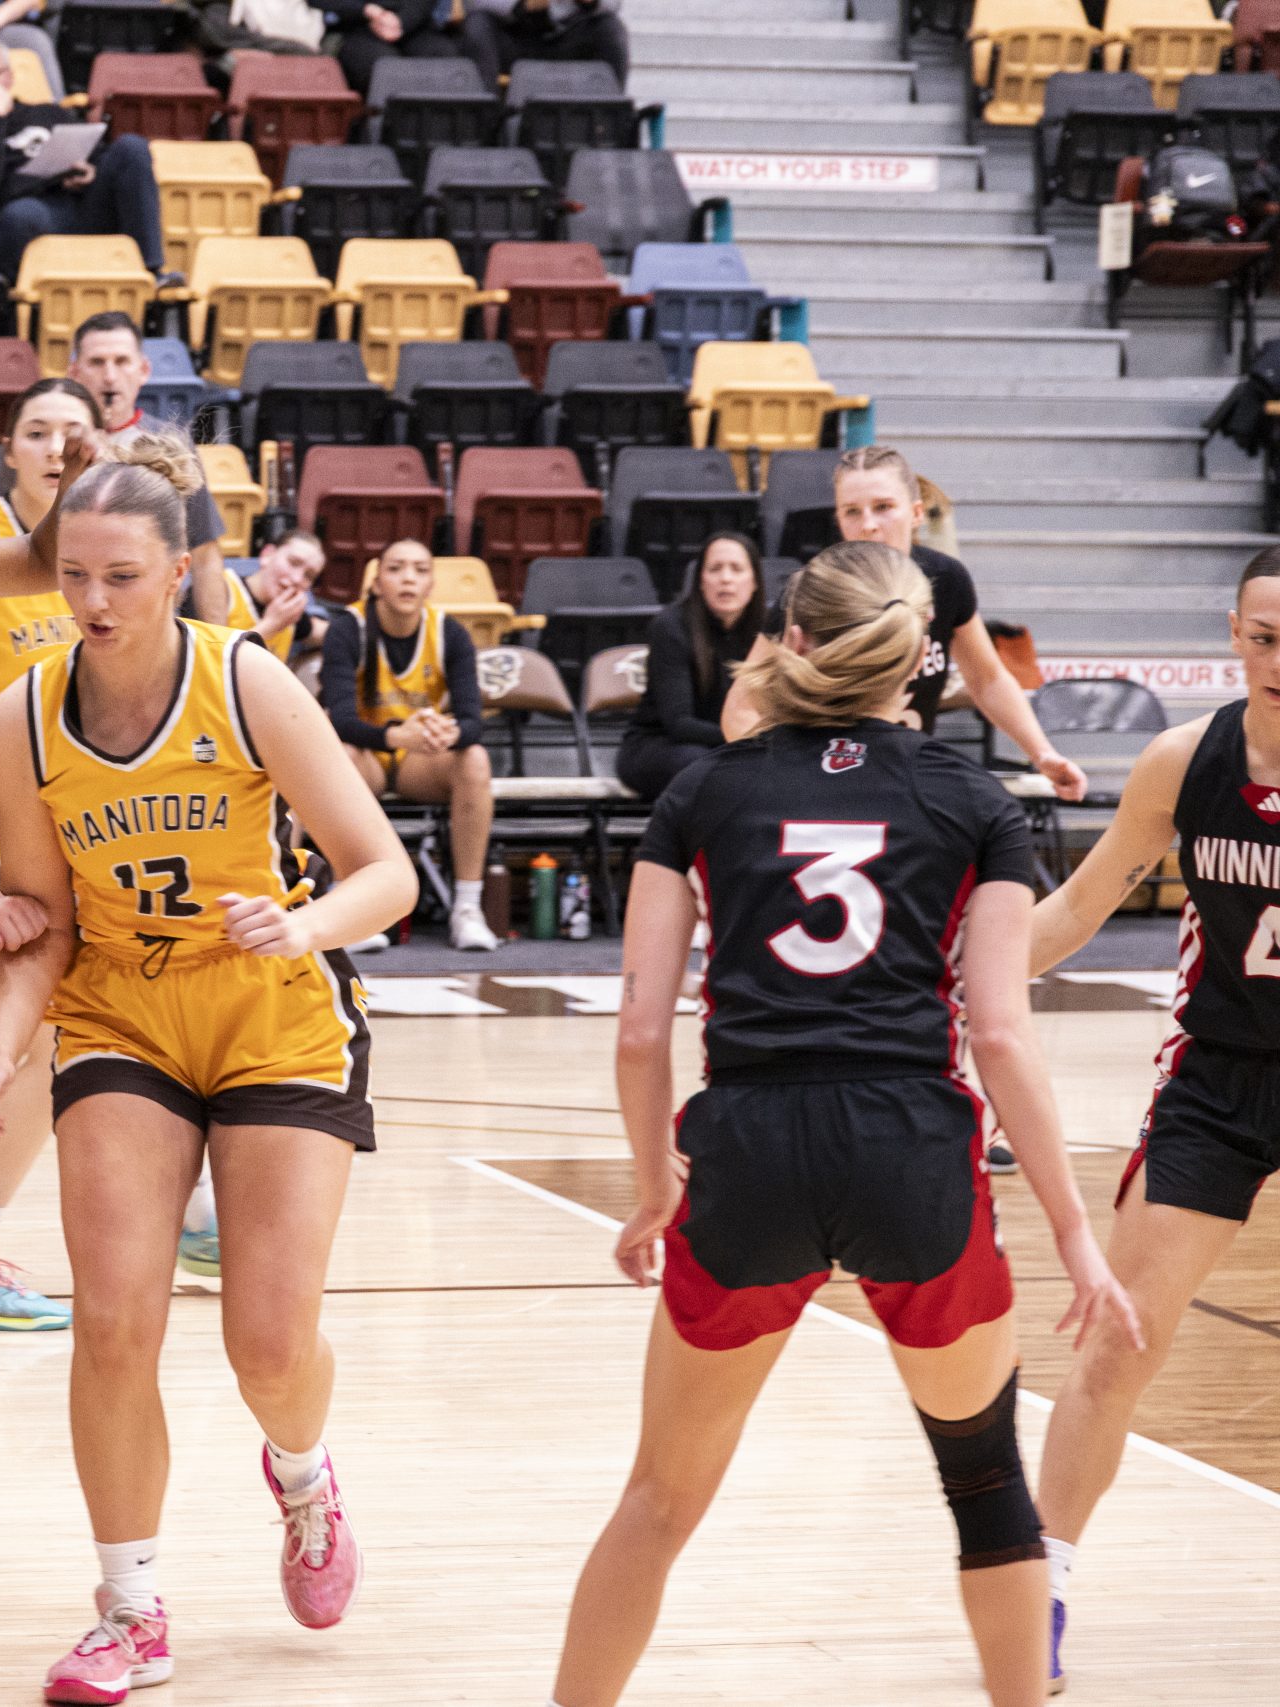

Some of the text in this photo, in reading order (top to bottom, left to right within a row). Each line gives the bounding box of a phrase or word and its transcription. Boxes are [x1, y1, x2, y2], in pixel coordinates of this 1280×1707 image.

[686, 159, 909, 181] WATCH YOUR STEP
[1137, 664, 1213, 687] YOUR
[58, 793, 229, 857] MANITOBA
[110, 854, 205, 919] 12
[765, 819, 890, 978] 3
